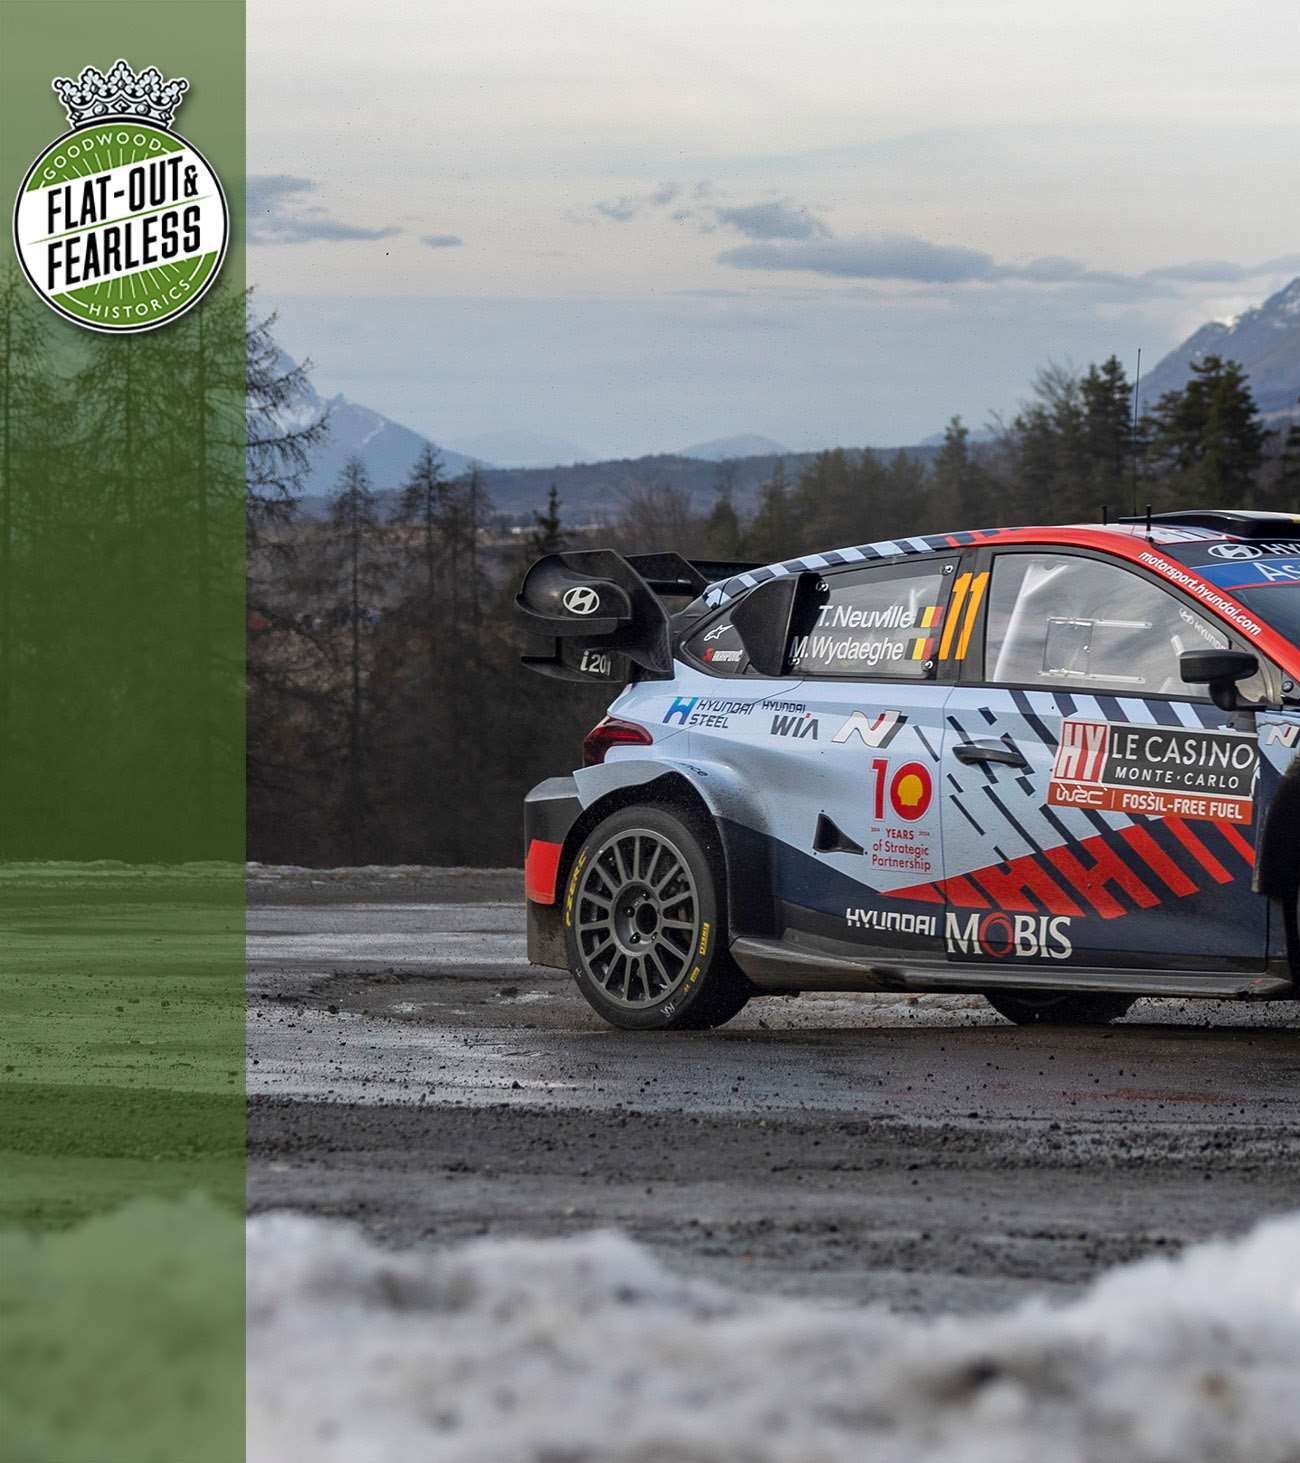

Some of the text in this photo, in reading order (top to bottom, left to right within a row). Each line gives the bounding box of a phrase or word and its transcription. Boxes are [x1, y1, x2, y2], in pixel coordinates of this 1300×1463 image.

[1137, 551, 1263, 637] motorsport.hyundai.com
[937, 571, 991, 661] 11
[688, 713, 729, 729] STEEL
[695, 699, 755, 715] HYUNDAI
[761, 700, 807, 714] HYUNDAI
[770, 713, 819, 741] WIA
[1112, 732, 1256, 770] LE CASINO
[871, 757, 934, 822] 10
[1121, 792, 1244, 820] FOSSIL-FREE FUEL
[885, 827, 915, 840] YEARS
[872, 840, 930, 858] of Strategic
[872, 854, 932, 873] Partnership
[845, 907, 937, 936] HYUNDAI
[944, 911, 1073, 960] MOBIS
